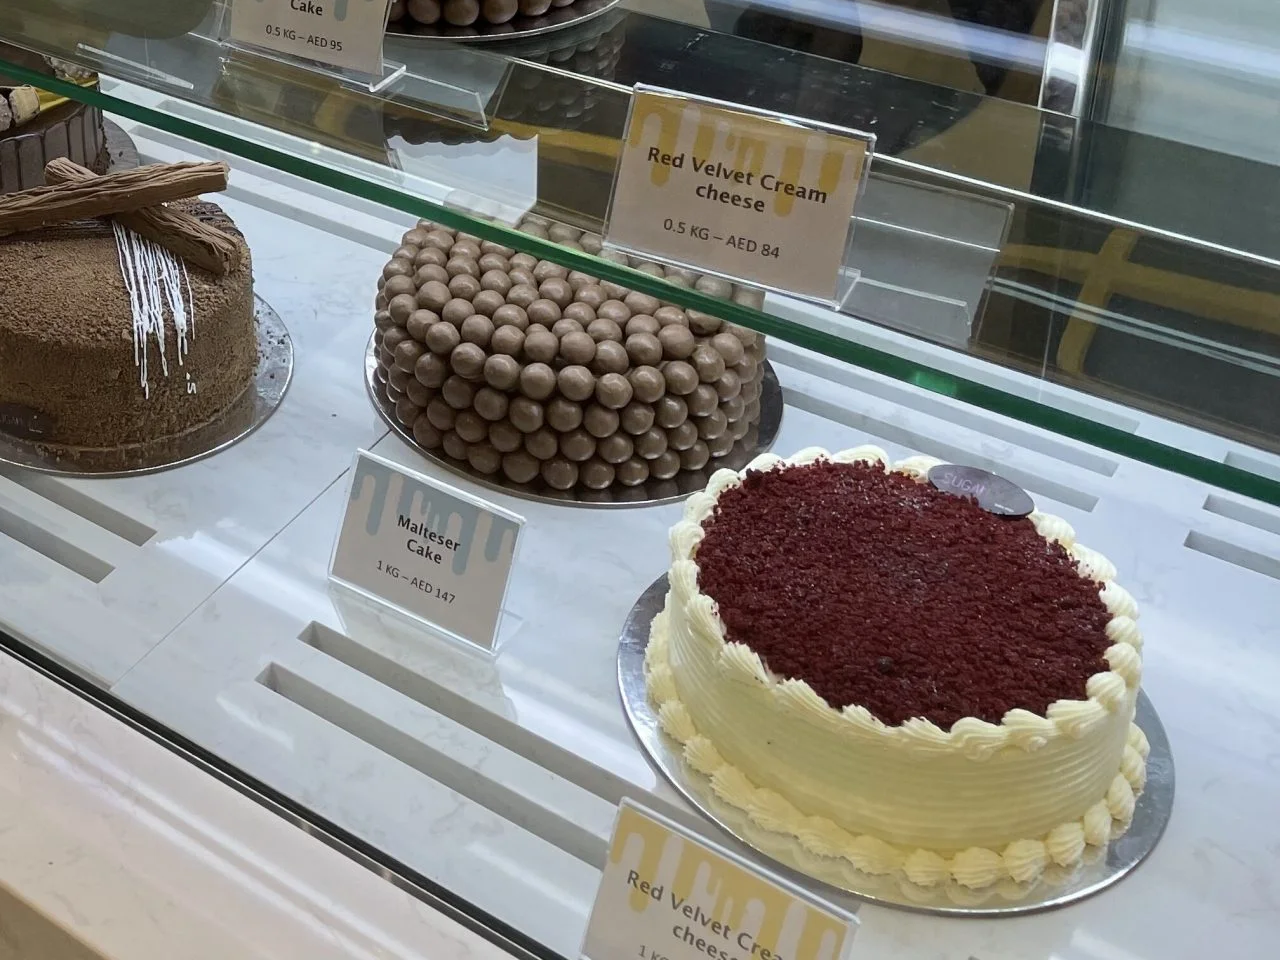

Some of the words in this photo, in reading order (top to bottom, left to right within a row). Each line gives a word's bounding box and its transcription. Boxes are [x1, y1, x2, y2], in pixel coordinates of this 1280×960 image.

[265, 24, 280, 36] 0.5
[283, 29, 296, 40] KG
[307, 34, 327, 48] AED
[330, 40, 343, 51] 95
[647, 147, 685, 169] Red
[692, 156, 754, 186] Velvet
[760, 174, 827, 204] Cream
[695, 183, 765, 213] cheese
[663, 218, 686, 234] 0.5
[690, 225, 709, 241] KG
[726, 233, 757, 253] AED
[761, 243, 780, 259] 84
[397, 514, 461, 552] Malteser
[407, 539, 442, 564] Cake
[376, 560, 382, 570] 1
[386, 565, 400, 578] KG
[411, 577, 433, 593] AED
[435, 588, 456, 604] 147
[626, 869, 664, 901] Red
[670, 892, 731, 940] Velvet
[737, 932, 784, 960] Crea
[673, 923, 738, 960] chees
